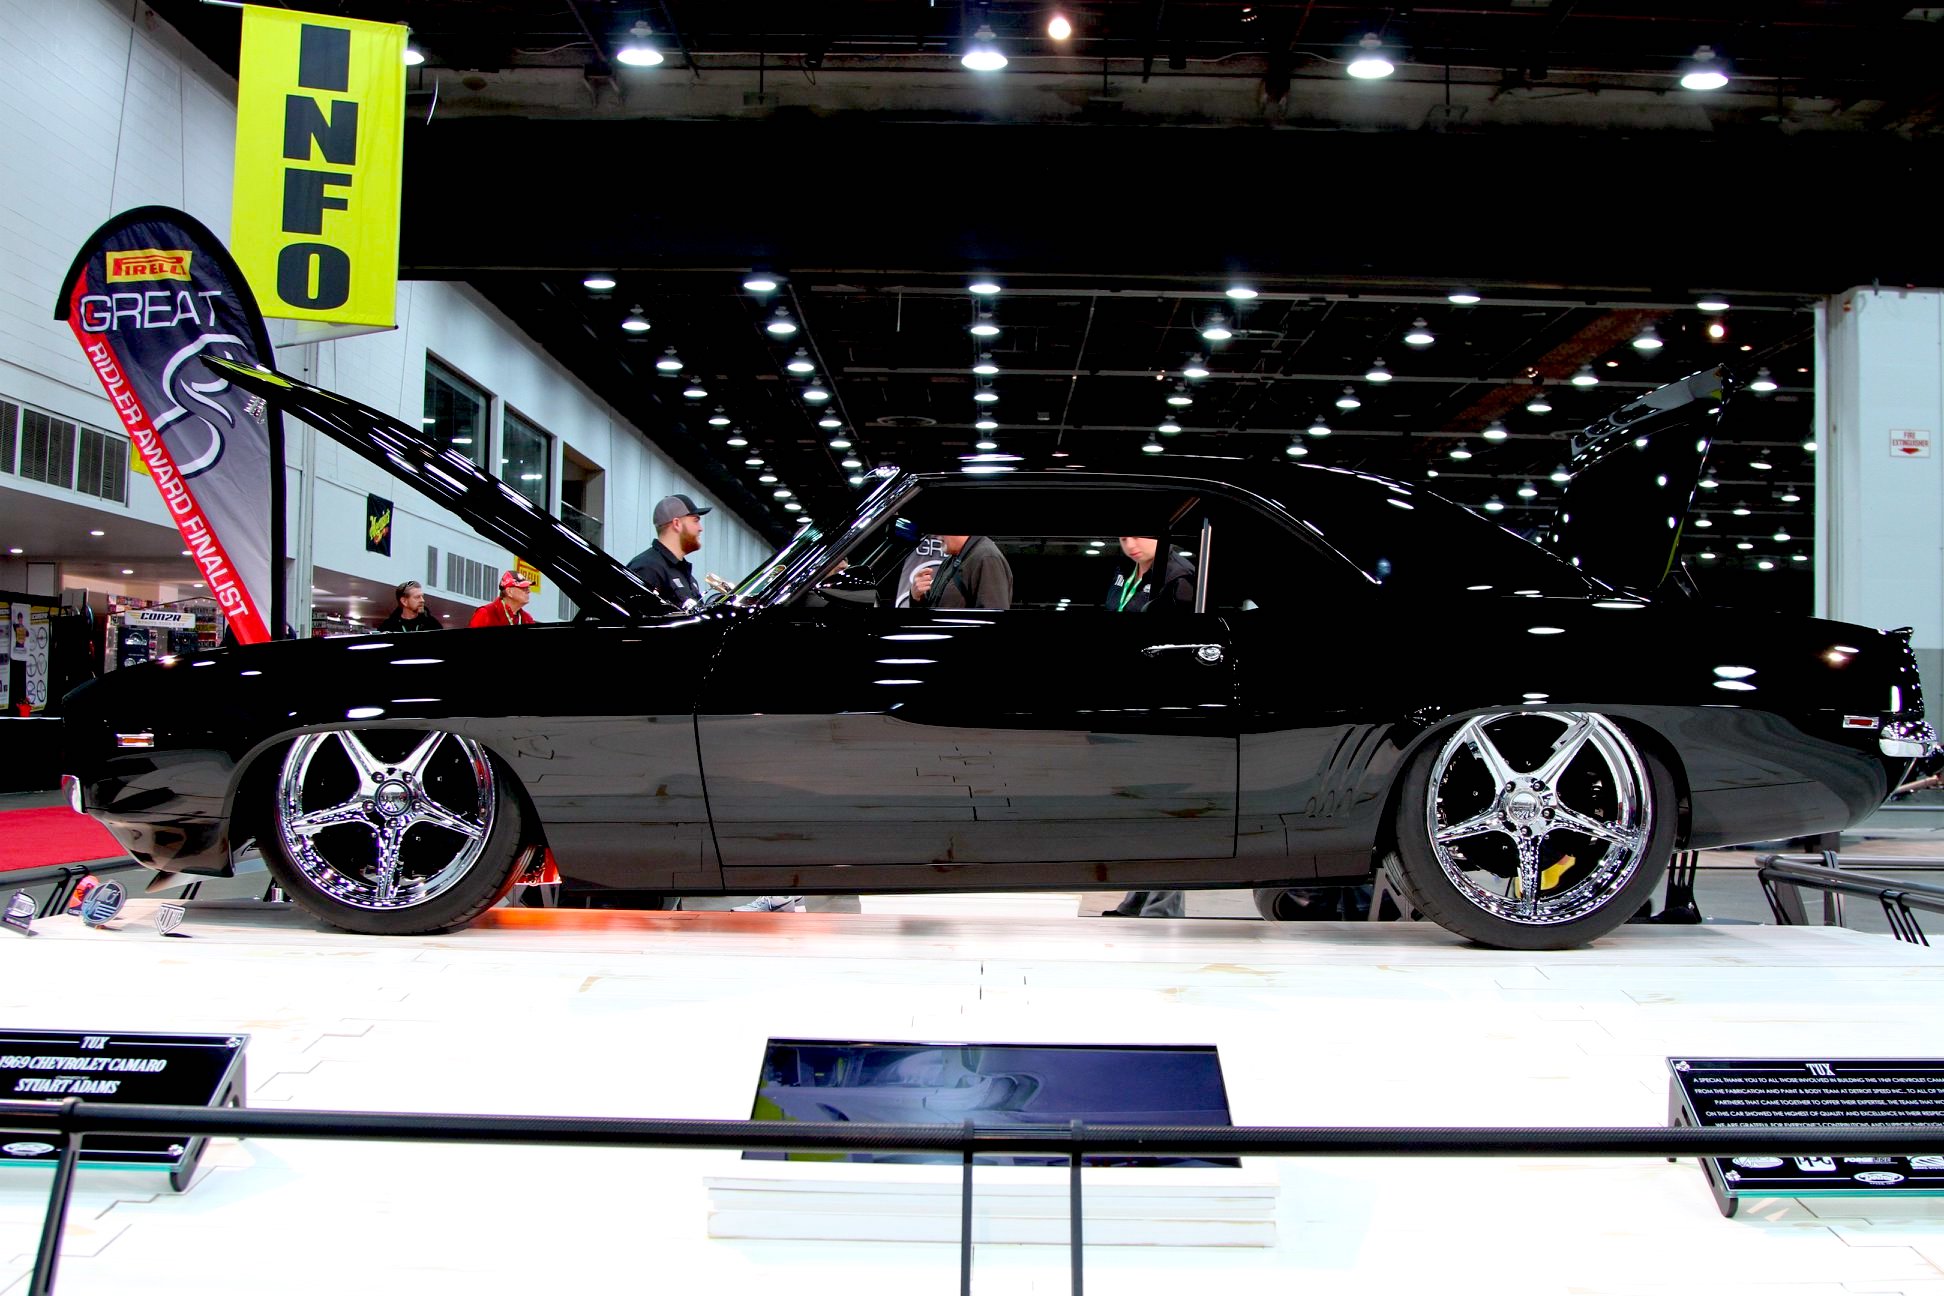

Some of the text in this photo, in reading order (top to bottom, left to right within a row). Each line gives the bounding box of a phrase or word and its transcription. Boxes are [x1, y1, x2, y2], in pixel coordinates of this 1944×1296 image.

[277, 24, 358, 310] INFO
[112, 254, 187, 277] PIRELLI
[80, 290, 221, 332] GREAT
[1903, 431, 1915, 439] FIRE
[88, 342, 249, 617] RIDLER AWARD FINALIST
[80, 1036, 110, 1050] TUX
[0, 1055, 167, 1072] 1969 CHEVROLET CAMARO
[1805, 1063, 1835, 1075] TUX
[14, 1078, 121, 1094] STUART ADAMS
